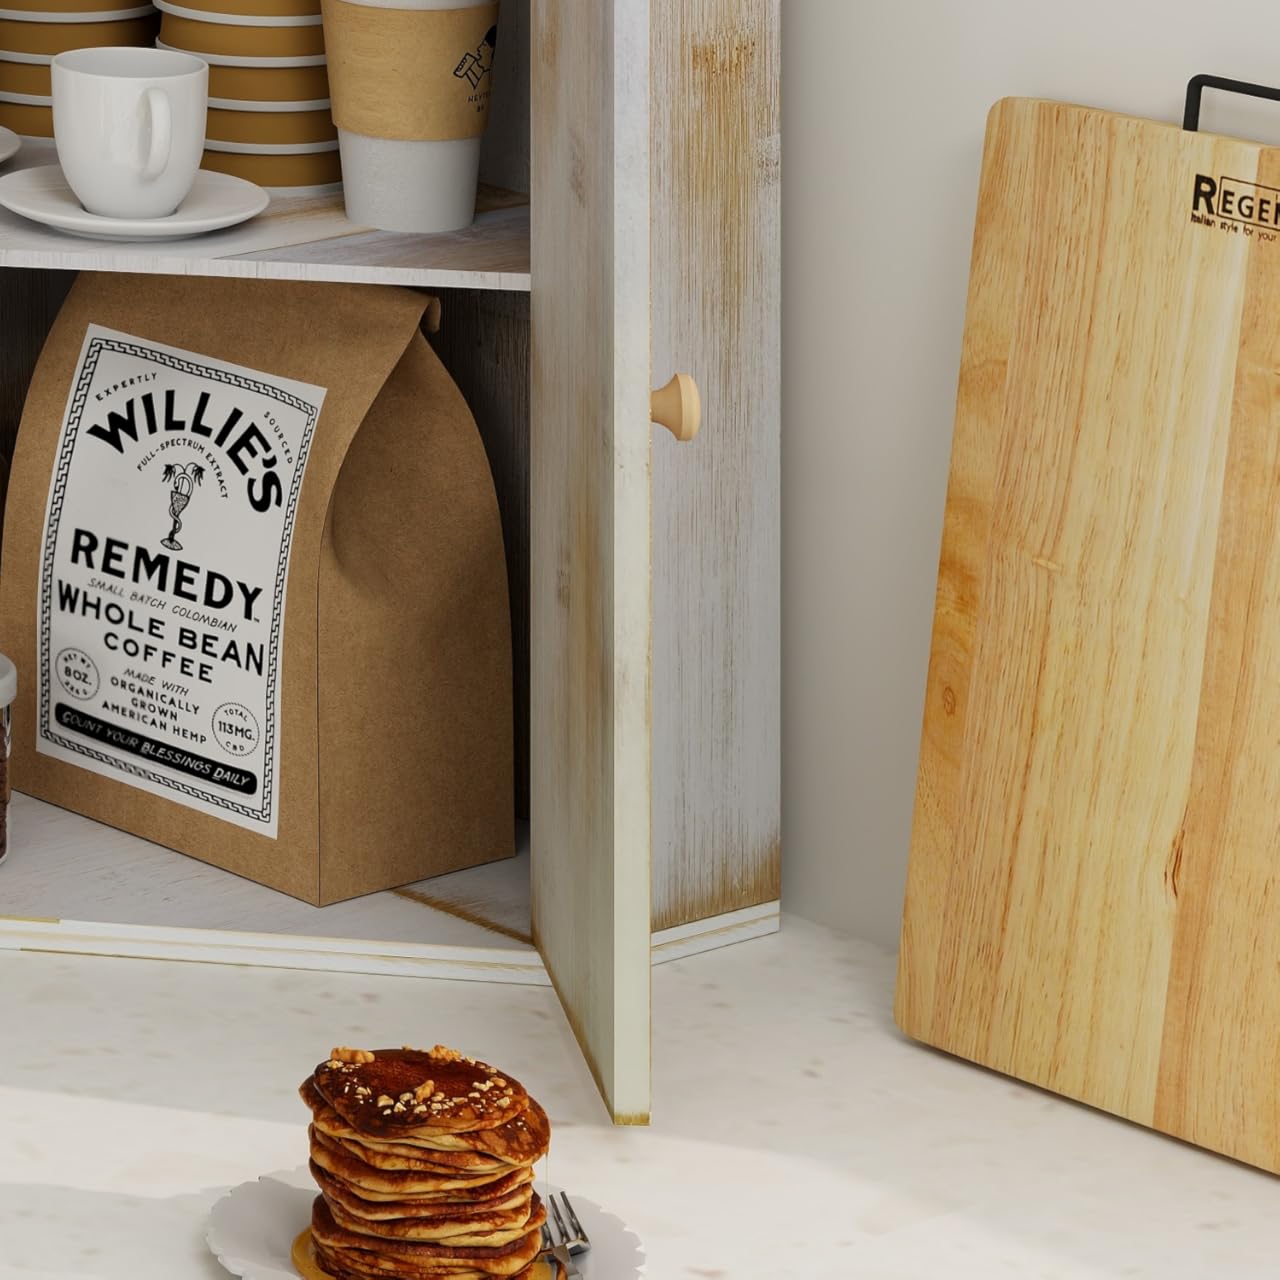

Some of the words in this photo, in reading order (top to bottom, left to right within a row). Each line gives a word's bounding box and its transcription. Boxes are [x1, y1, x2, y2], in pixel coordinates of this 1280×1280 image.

[1220, 221, 1238, 233] style
[1243, 225, 1254, 236] for
[1258, 232, 1277, 242] your
[95, 372, 158, 402] EXPERTLY
[264, 411, 293, 464] SOURCED
[137, 438, 205, 471] FULL-SPECTRUM
[205, 452, 228, 499] EXTRACT
[71, 528, 263, 621] REMEDY
[58, 579, 165, 640] WHOLE
[178, 626, 264, 677] BEAN
[88, 578, 124, 598] SMALL
[130, 591, 167, 610] BATCH
[172, 605, 238, 633] COLOMBIAN
[104, 632, 213, 683] COFFEE
[110, 676, 200, 715] ORGANICALLY
[124, 668, 156, 686] MADE
[162, 680, 189, 696] WITH
[102, 700, 167, 731] AMERICAN
[173, 725, 207, 744] HEMP
[131, 697, 178, 721] GROWN
[224, 708, 248, 722] TOTAL
[62, 711, 103, 733] COUNT
[106, 728, 139, 747] YOUR
[140, 741, 212, 774] BLESSINGS
[212, 768, 251, 786] DAILY
[225, 741, 245, 751] CBD
